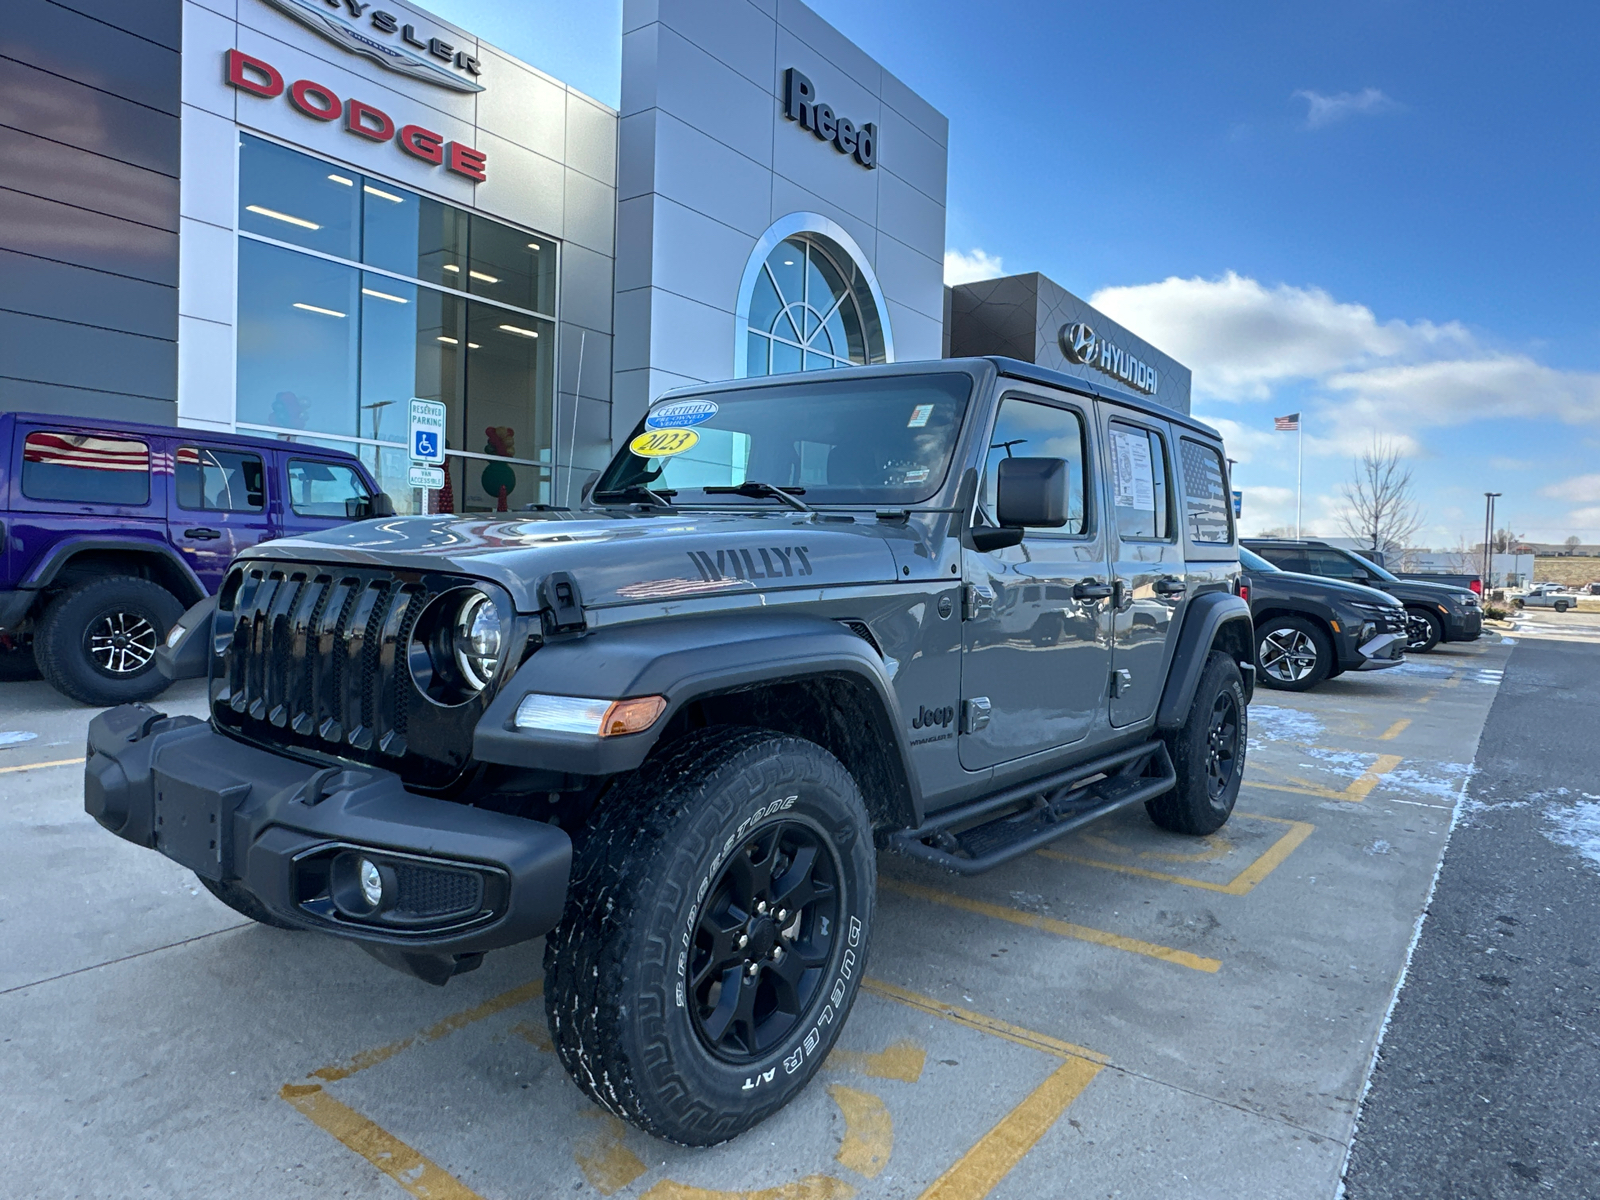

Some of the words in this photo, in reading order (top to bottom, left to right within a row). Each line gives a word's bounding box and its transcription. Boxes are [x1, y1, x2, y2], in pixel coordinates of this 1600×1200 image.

[323, 0, 482, 75] YSLER
[225, 48, 487, 182] DODGE
[784, 67, 878, 170] Reed
[1100, 339, 1158, 395] HYUNDAI
[413, 405, 441, 416] RESERVED
[413, 415, 441, 427] PARKING
[657, 404, 712, 416] CERTIFIED
[637, 433, 690, 450] 2023
[411, 477, 441, 485] ACCESSIBLE
[686, 546, 813, 582] WILLYS
[913, 705, 954, 729] Jeep
[675, 795, 798, 1008] BRIDGESTONE
[783, 915, 862, 1075] DUELER
[741, 1066, 776, 1090] A/T
